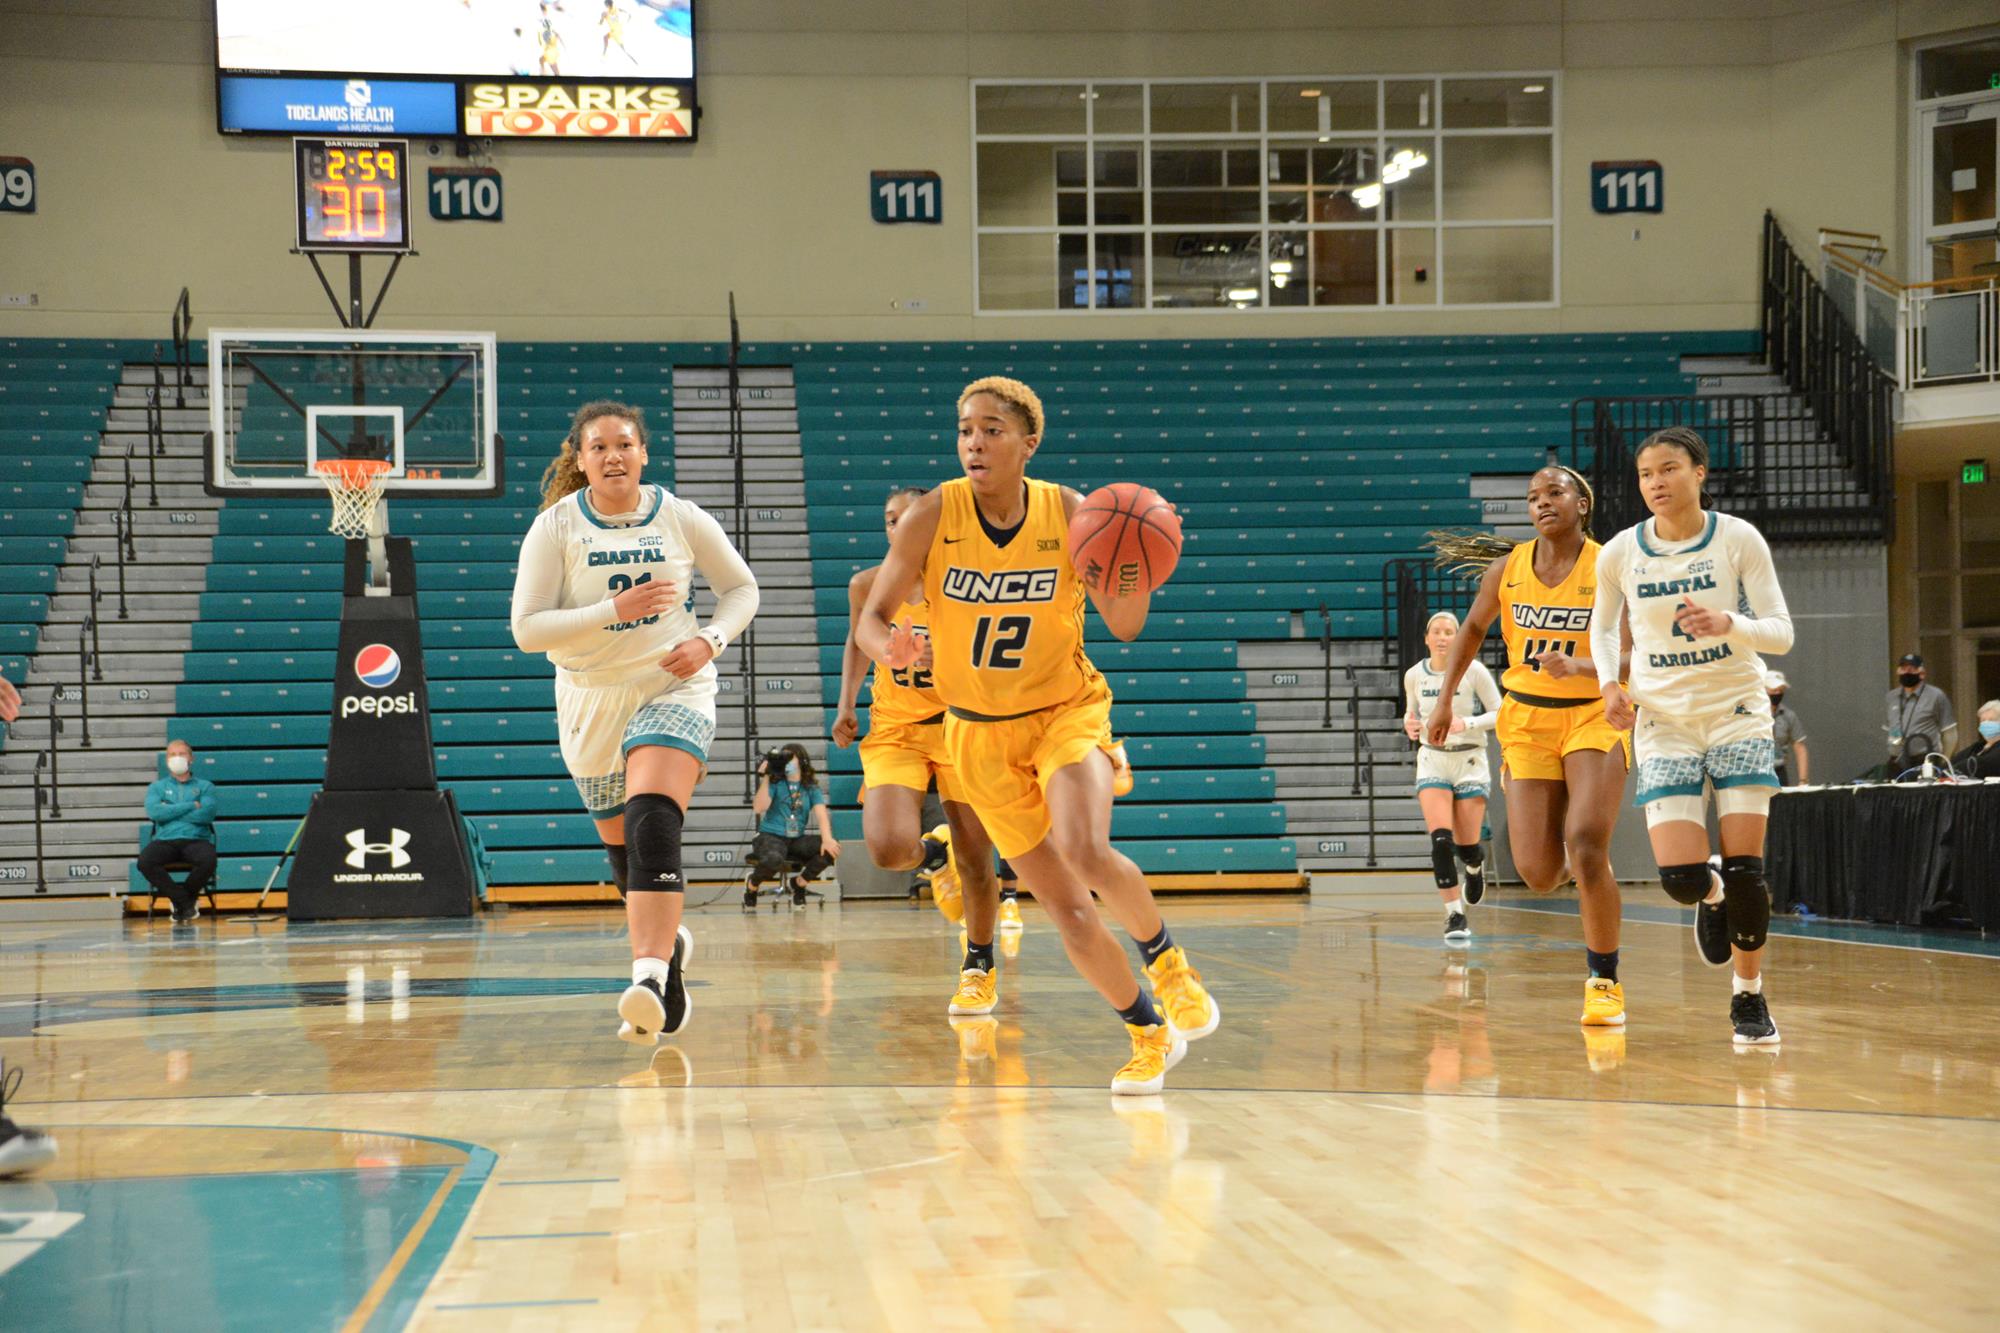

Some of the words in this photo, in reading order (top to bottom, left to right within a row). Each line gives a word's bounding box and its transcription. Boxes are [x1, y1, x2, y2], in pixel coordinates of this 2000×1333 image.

[473, 84, 681, 110] SPARKS
[286, 104, 348, 122] TIDELANDS
[350, 106, 394, 122] HEALTH
[469, 111, 688, 136] TOYOTA
[327, 150, 396, 181] 2:59
[433, 178, 499, 216] 110
[879, 182, 934, 217] 111
[1600, 171, 1656, 208] 111
[323, 184, 386, 238] 30
[588, 548, 666, 567] COASTAL
[608, 572, 652, 598] 2
[943, 567, 1058, 604] UNCG
[1637, 573, 1717, 598] COASTAL
[1511, 603, 1593, 632] UNCG
[972, 614, 1032, 670] 12
[1649, 642, 1733, 668] CAROLINA
[341, 692, 416, 718] pepsi
[8, 868, 26, 879] 109
[333, 874, 373, 883] UNDER
[374, 873, 422, 882] ARMOUR
